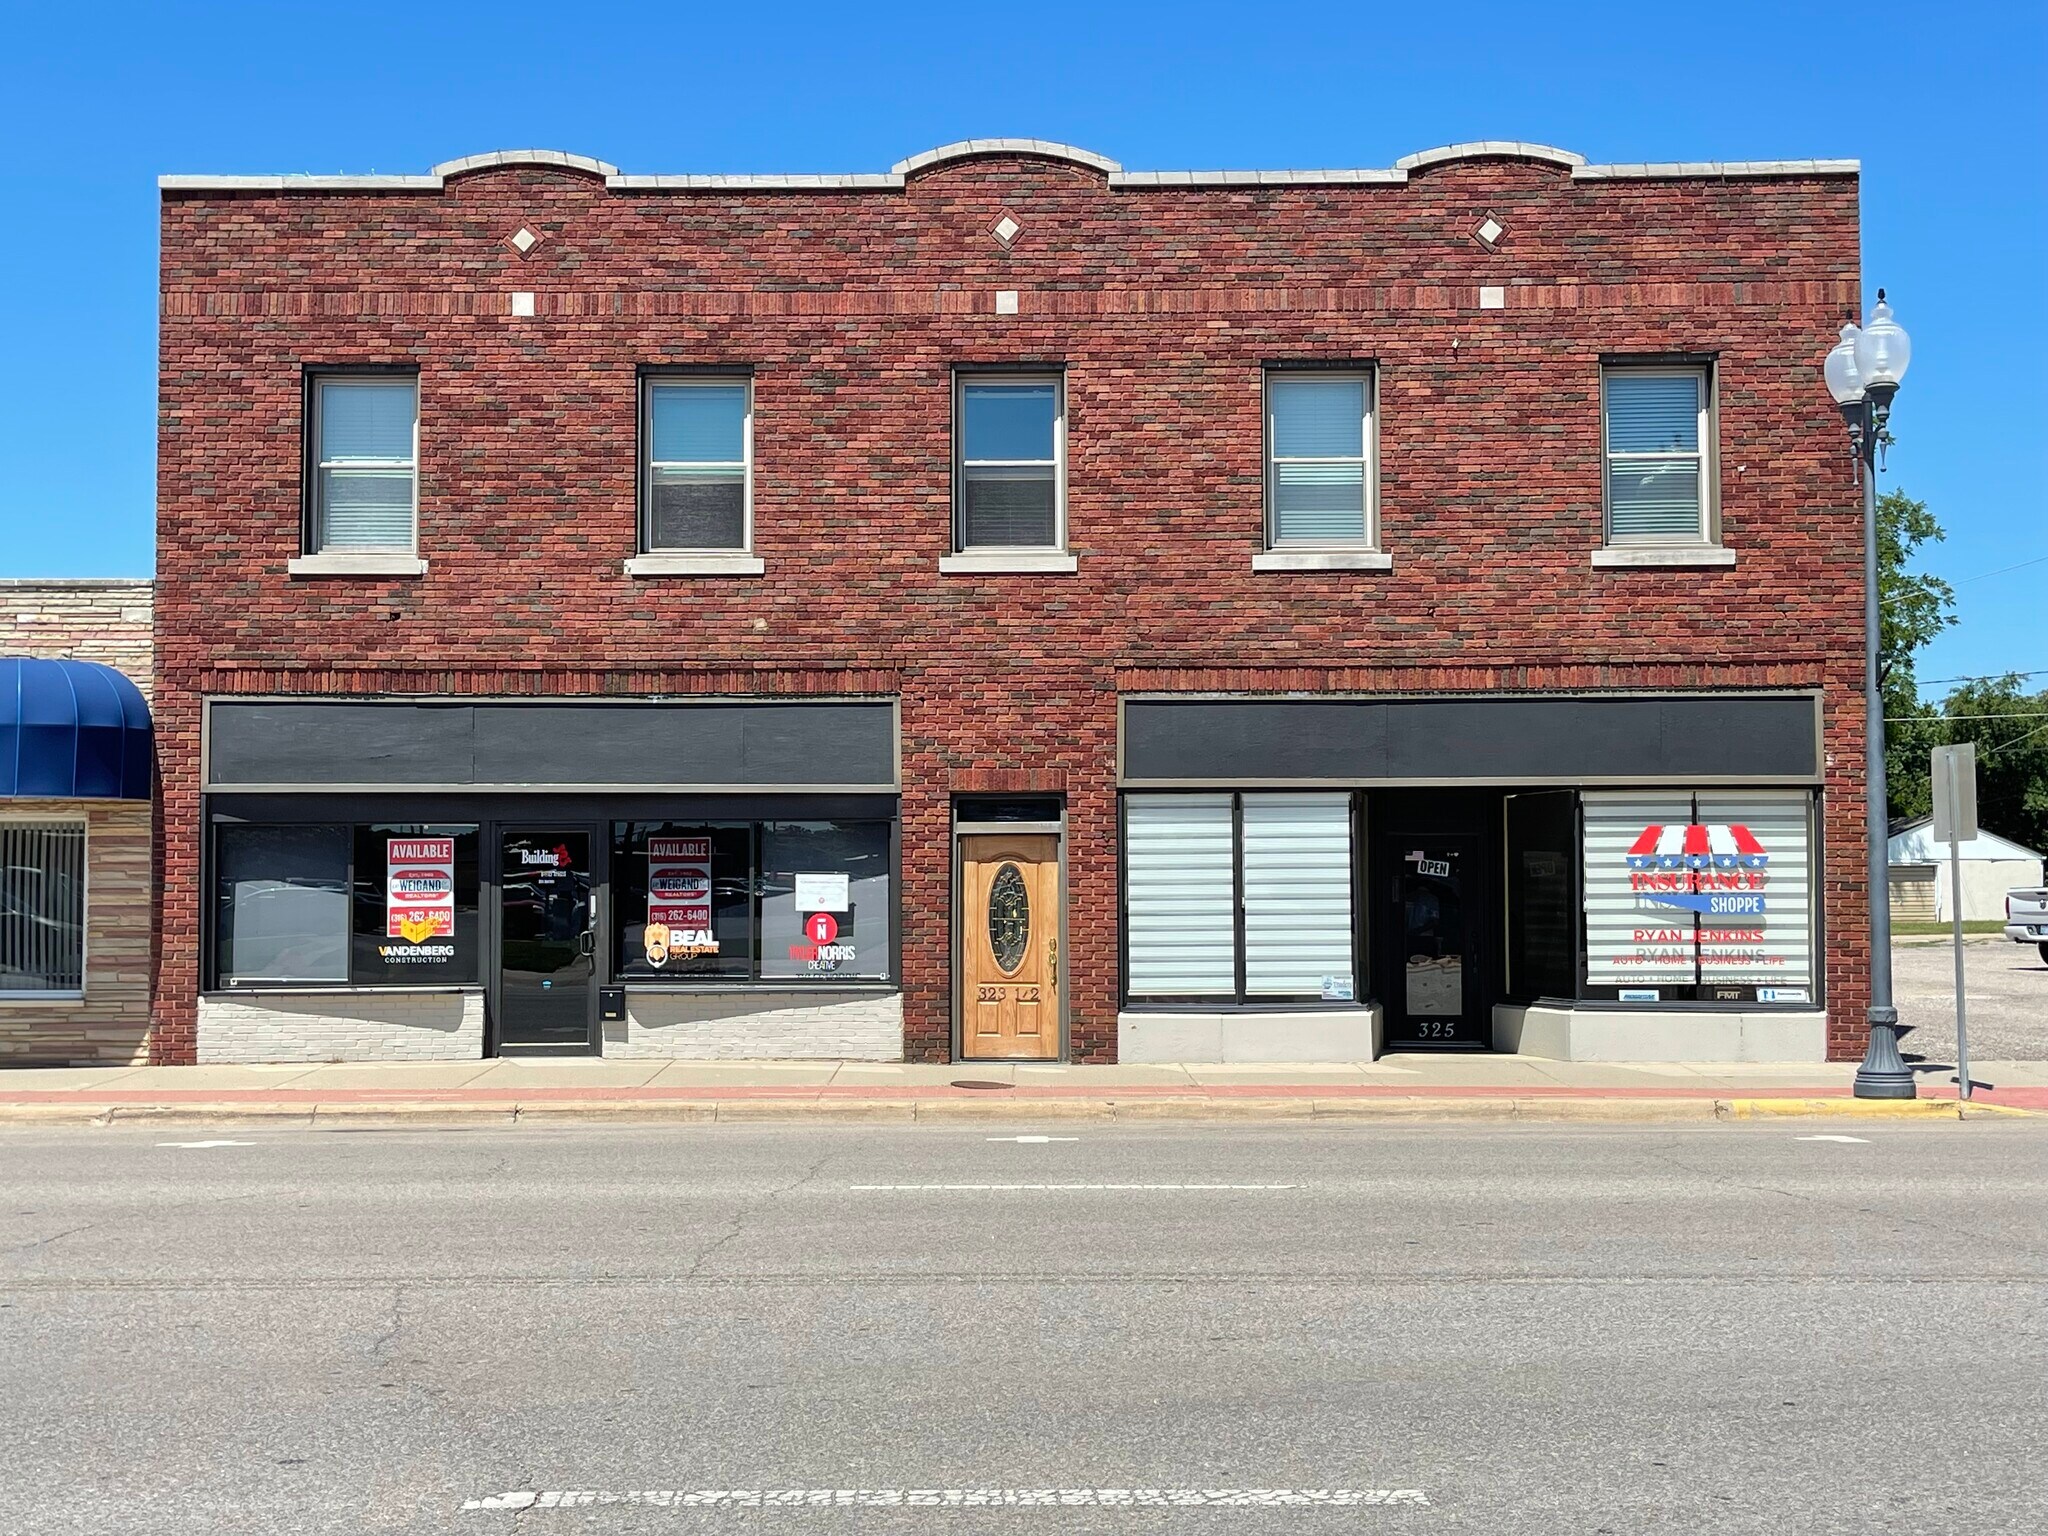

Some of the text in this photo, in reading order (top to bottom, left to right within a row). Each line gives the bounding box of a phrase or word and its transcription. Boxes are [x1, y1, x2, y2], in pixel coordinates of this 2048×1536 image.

[391, 843, 451, 859] AVAILABLE
[652, 843, 708, 857] AVAILABLE
[521, 849, 559, 867] Building
[1419, 860, 1448, 876] OPEN
[400, 879, 441, 892] WEIGAND
[659, 878, 700, 890] WEIGAND
[1631, 871, 1767, 892] INSURANCE
[1710, 896, 1760, 913] SHOPPE
[408, 910, 451, 923] 262-6400
[651, 909, 708, 922] (316) 262-6400
[670, 929, 720, 947] BEAL
[1633, 929, 1764, 943] RYAN JENKINS
[378, 945, 454, 956] VANDENBERG
[807, 960, 836, 970] CREATIVE
[1612, 956, 1643, 965] AUTO
[1654, 956, 1687, 965] HOME
[1697, 956, 1751, 966] BUSINESS
[978, 987, 1040, 1001] 323 1/2
[1418, 1022, 1455, 1038] 325
